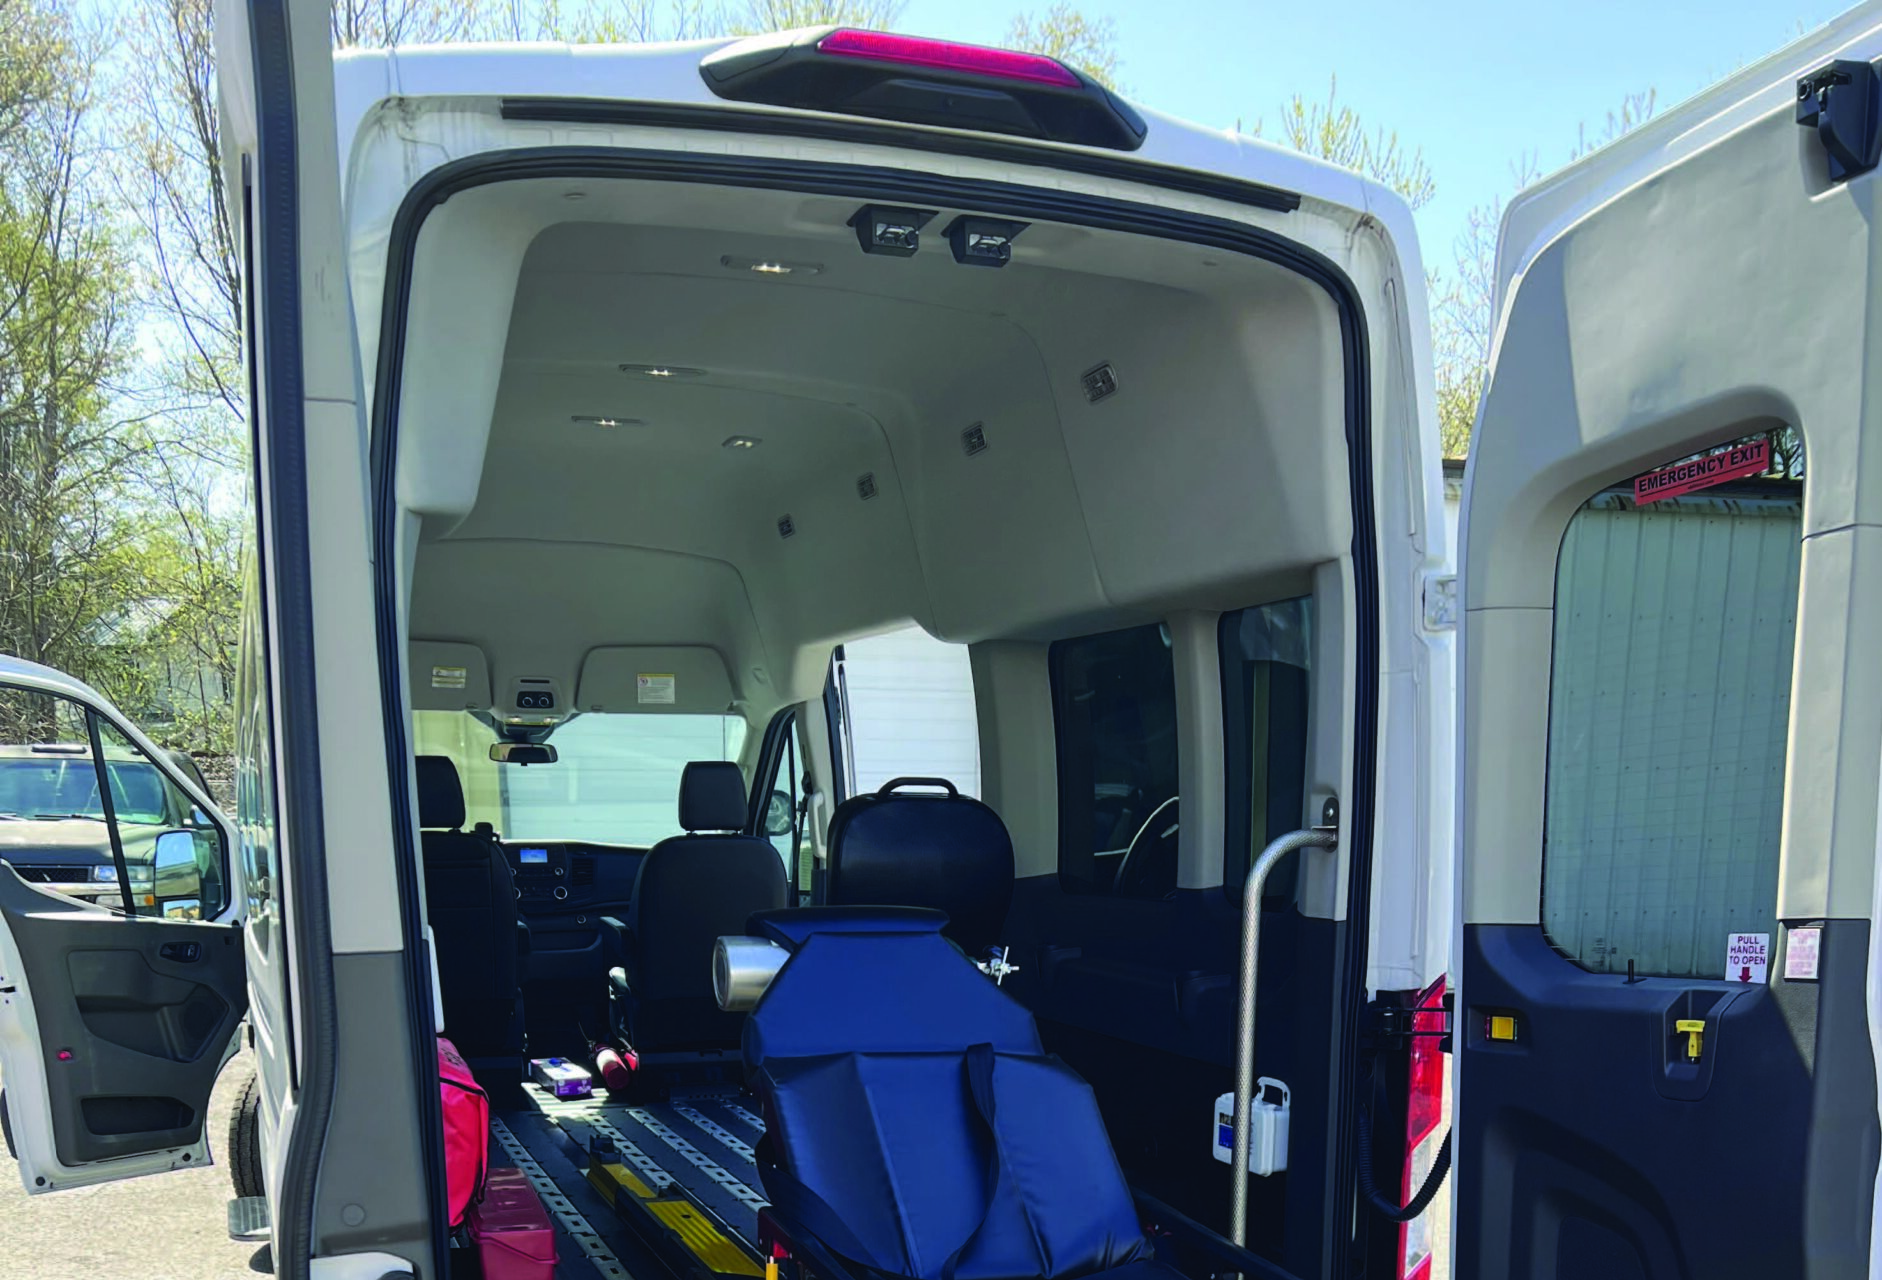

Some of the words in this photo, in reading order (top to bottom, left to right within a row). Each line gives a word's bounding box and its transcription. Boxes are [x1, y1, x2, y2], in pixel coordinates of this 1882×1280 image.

[1639, 455, 1726, 492] EMERGENCY
[1730, 444, 1764, 466] EXIT
[1737, 936, 1760, 944] PULL
[1730, 946, 1766, 954] HANDLE
[1729, 955, 1740, 965] TO
[1742, 956, 1766, 965] OPEN
